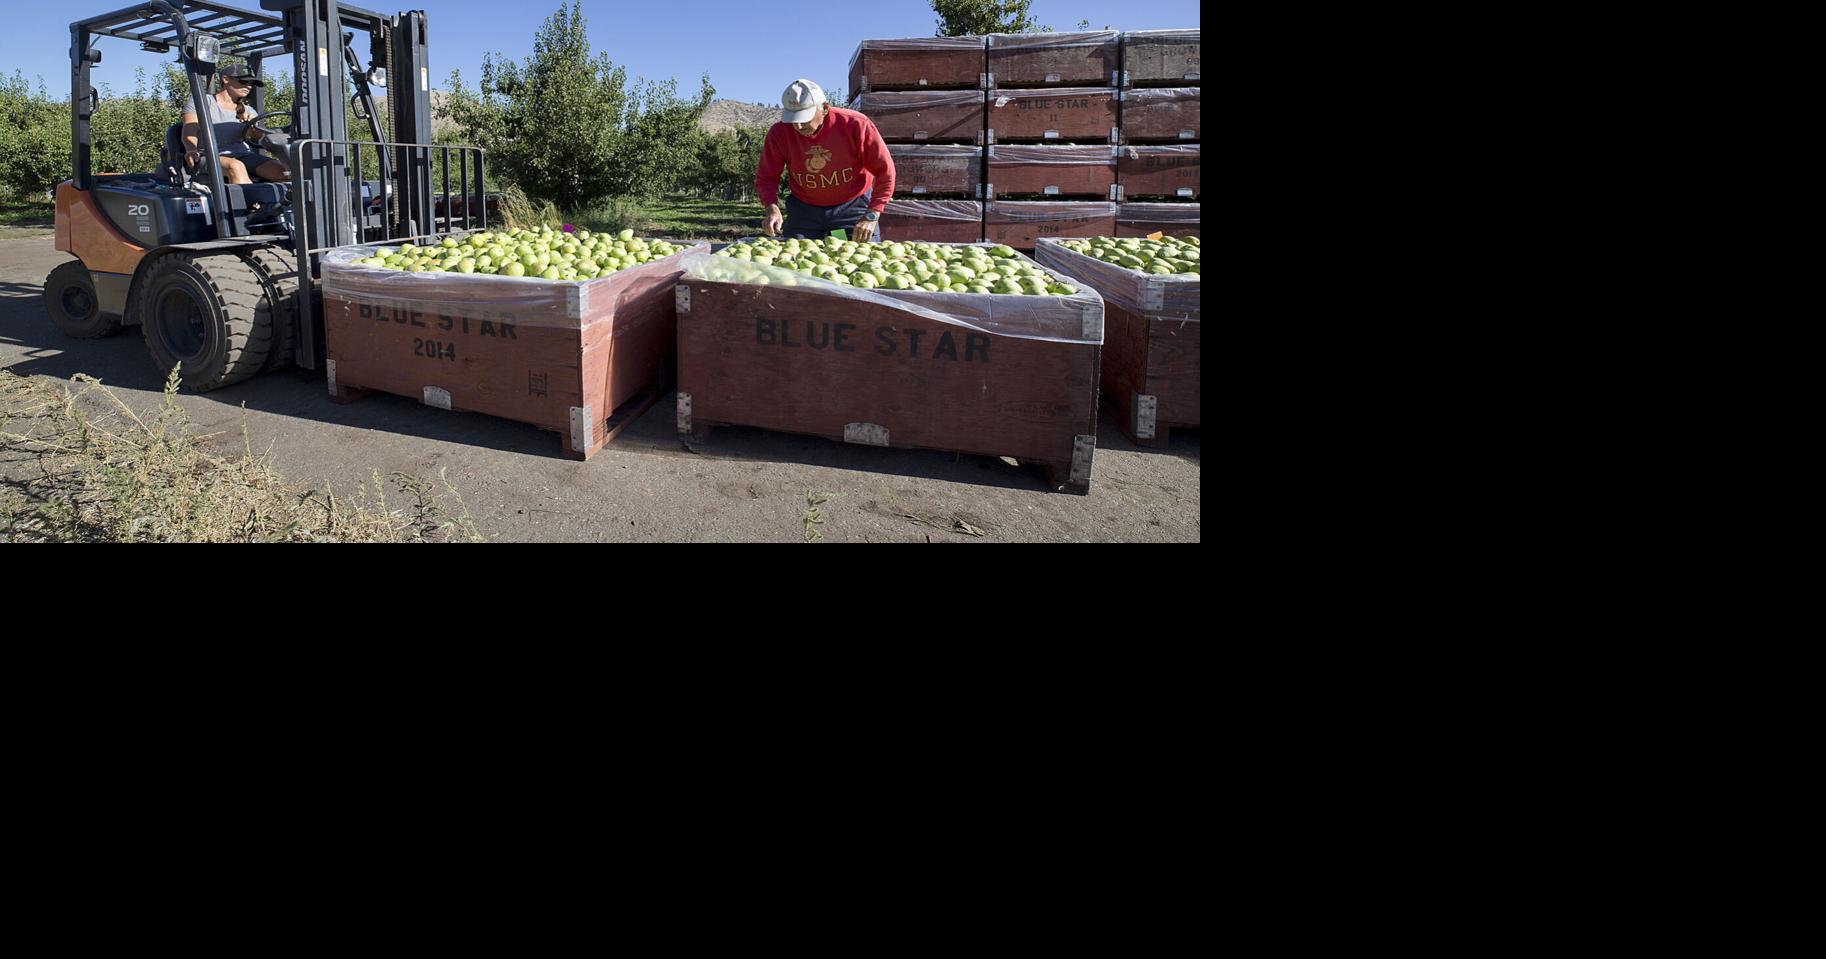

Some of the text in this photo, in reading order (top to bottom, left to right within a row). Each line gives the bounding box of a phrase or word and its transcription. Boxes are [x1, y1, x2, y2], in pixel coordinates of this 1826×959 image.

[300, 40, 309, 104] DOOSAN
[1019, 99, 1089, 110] BLUE STAR
[1146, 156, 1184, 168] BLUE
[128, 204, 149, 216] 20
[1037, 225, 1059, 233] 2014
[358, 299, 518, 341] BLUE STAR
[413, 336, 457, 362] 2014
[755, 317, 993, 364] BLUE STAR
